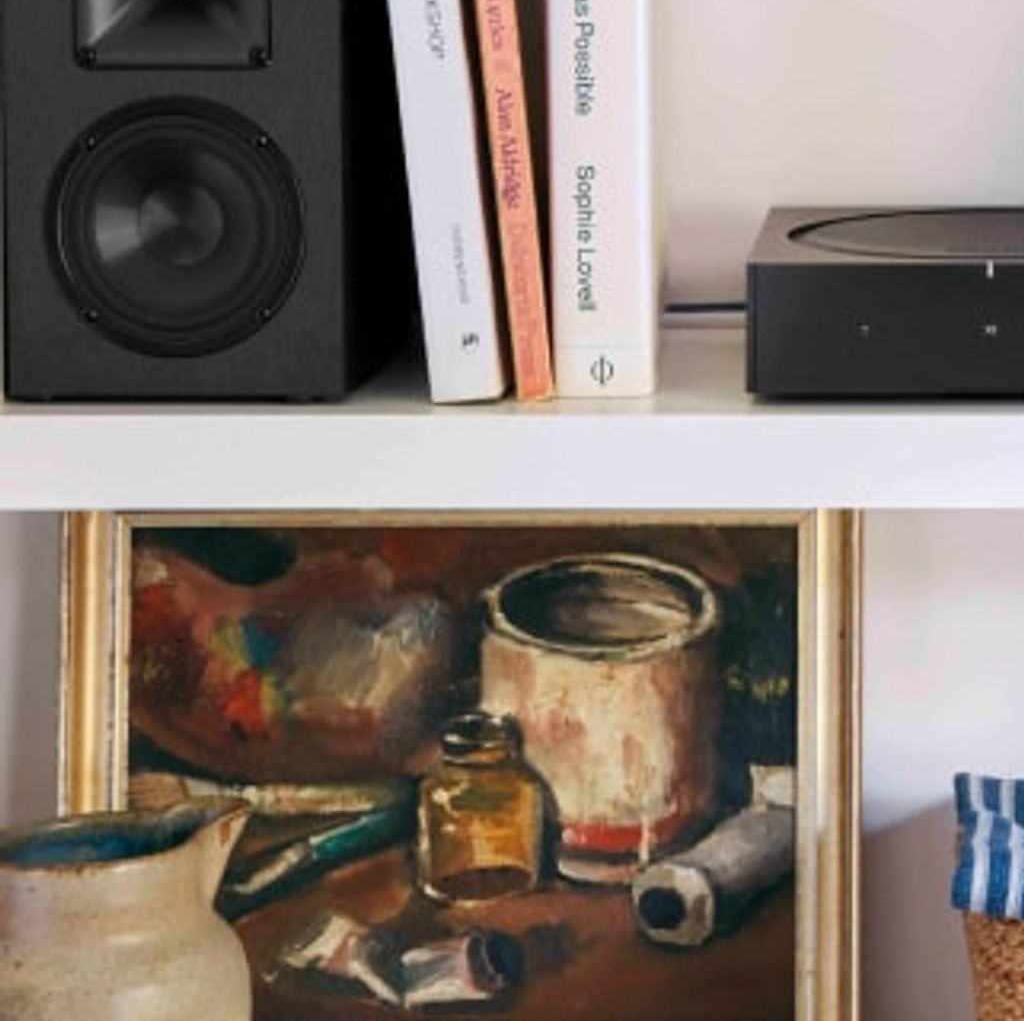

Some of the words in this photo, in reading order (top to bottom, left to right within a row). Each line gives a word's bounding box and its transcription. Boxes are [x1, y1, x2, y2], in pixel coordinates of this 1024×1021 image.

[574, 21, 595, 116] Possible
[572, 165, 596, 242] Sophie
[576, 248, 596, 311] Lovell
